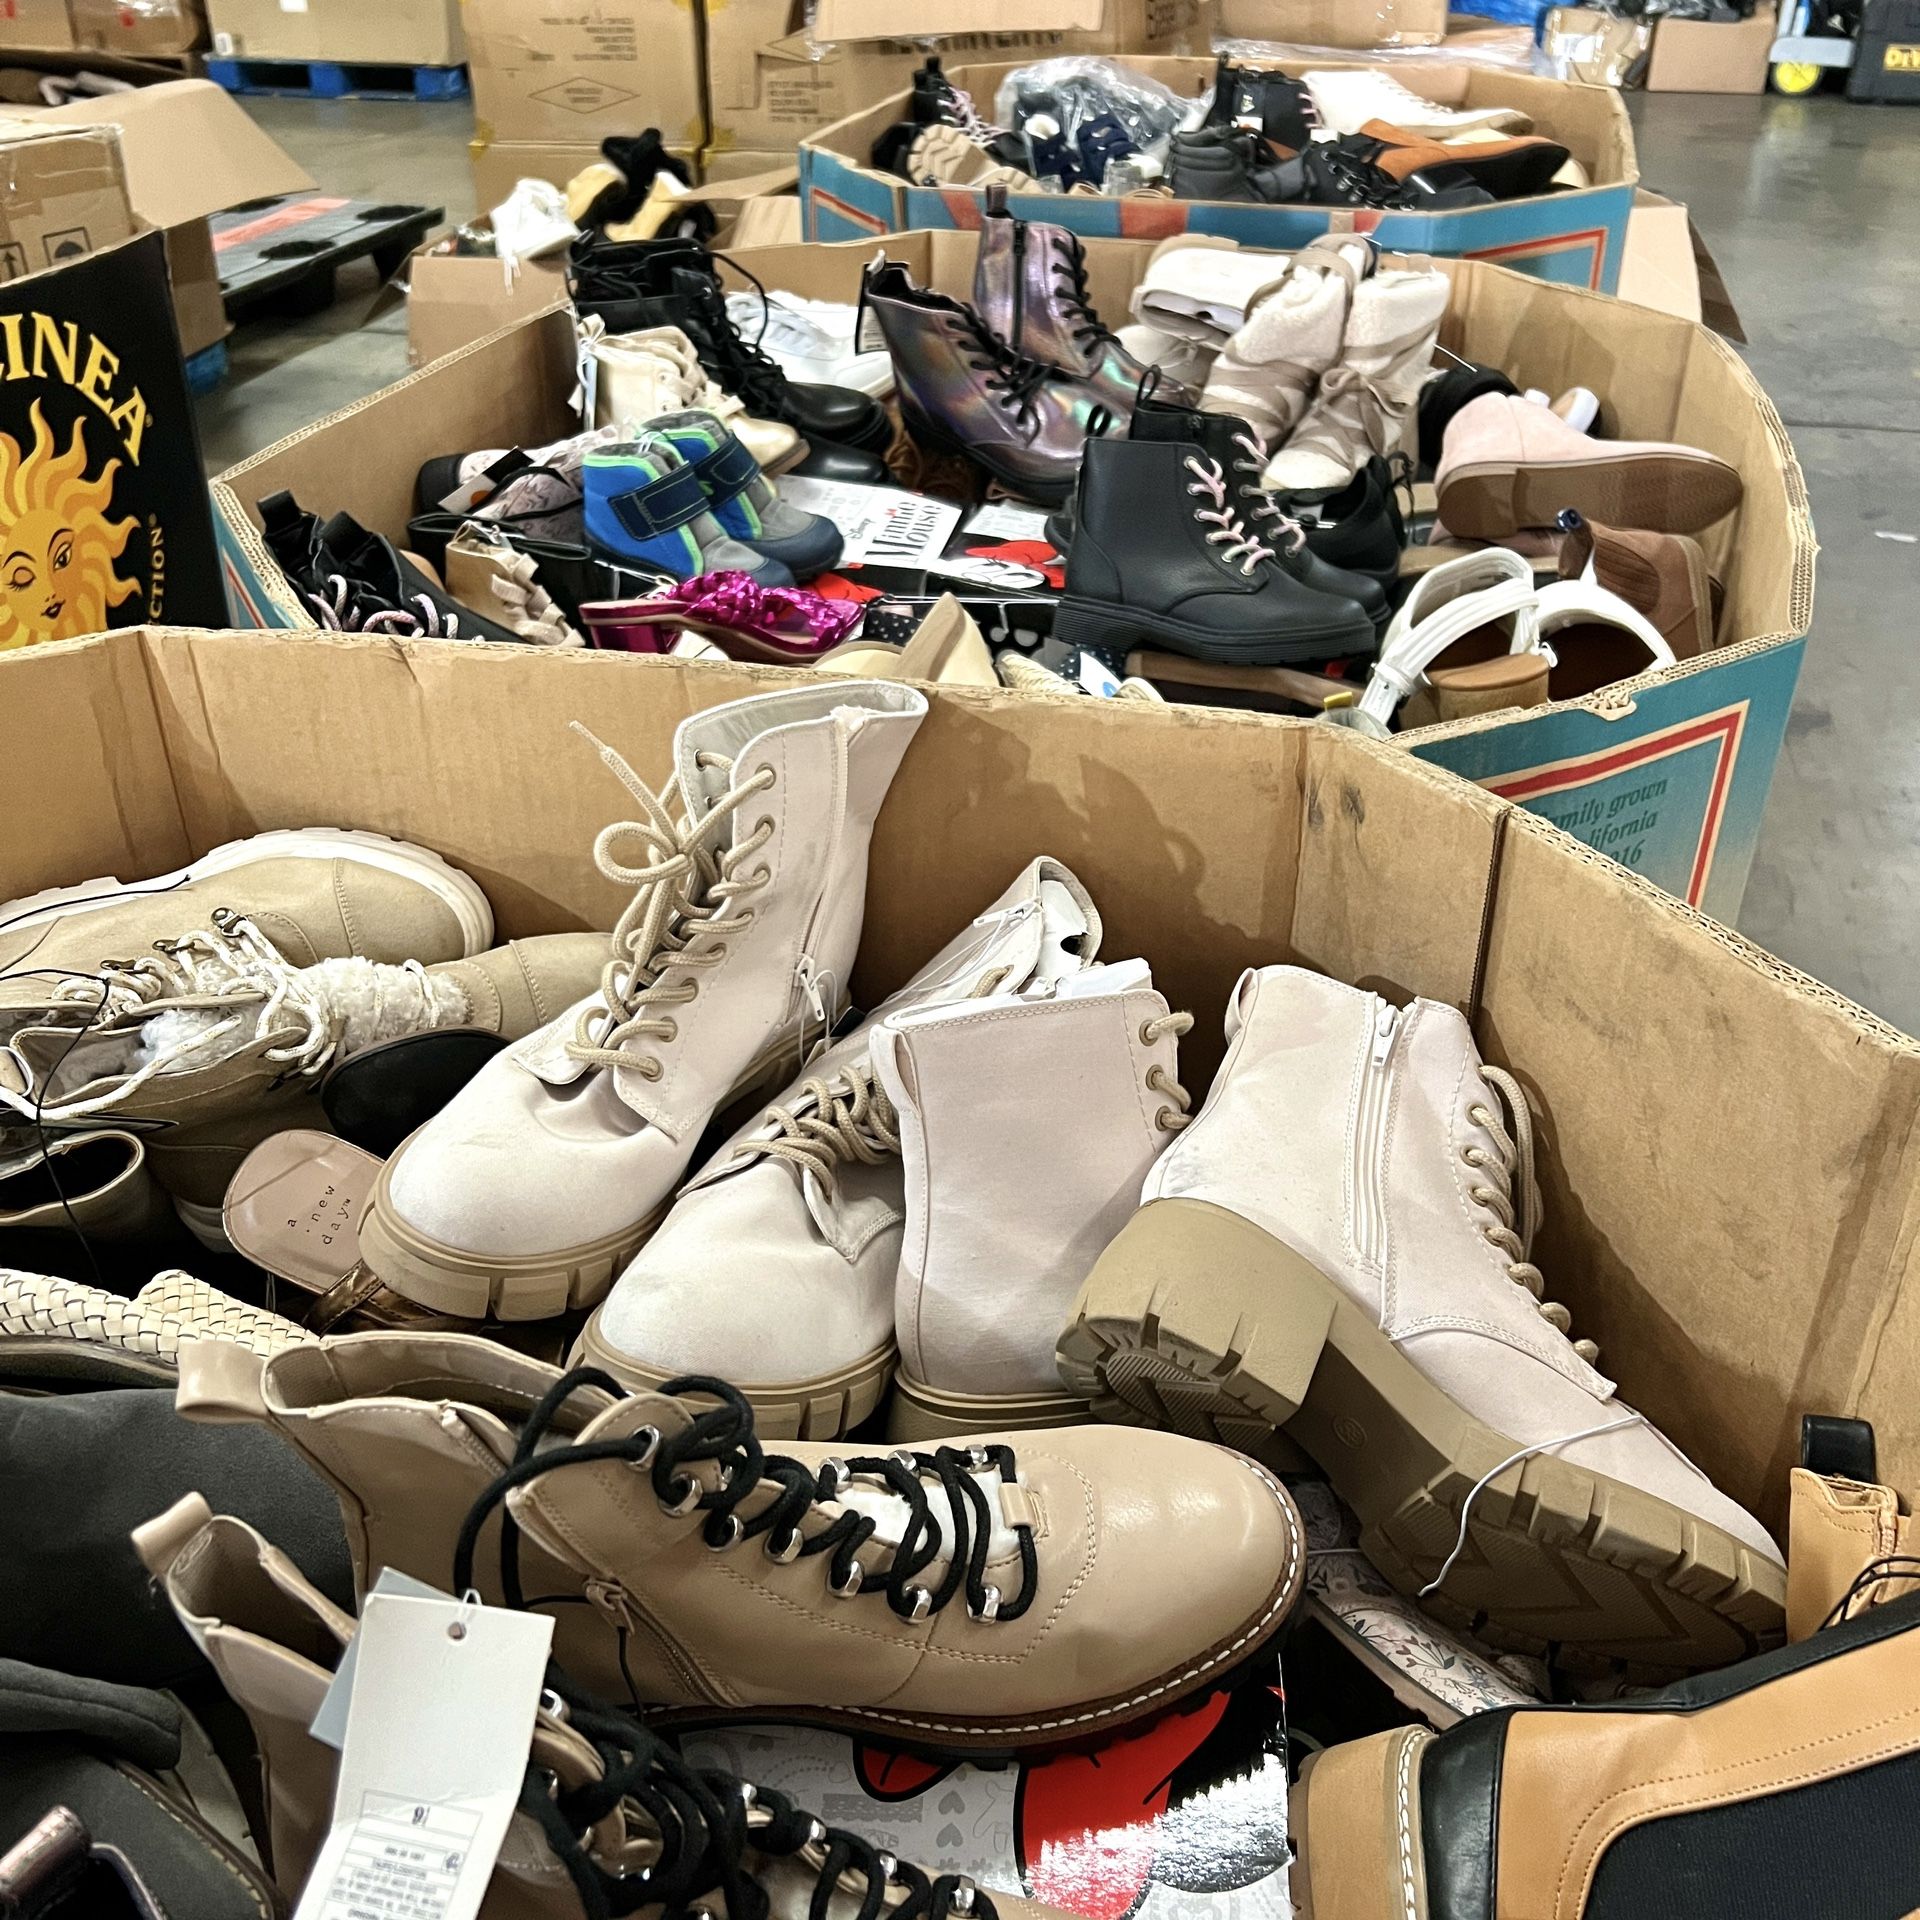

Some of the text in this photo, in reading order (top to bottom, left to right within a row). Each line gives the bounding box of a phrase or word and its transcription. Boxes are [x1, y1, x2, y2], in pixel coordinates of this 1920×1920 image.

[0, 311, 147, 467] INEA
[148, 527, 165, 625] CTION
[1542, 778, 1668, 829] mily grown
[287, 1218, 298, 1228] a
[311, 1185, 335, 1222] new
